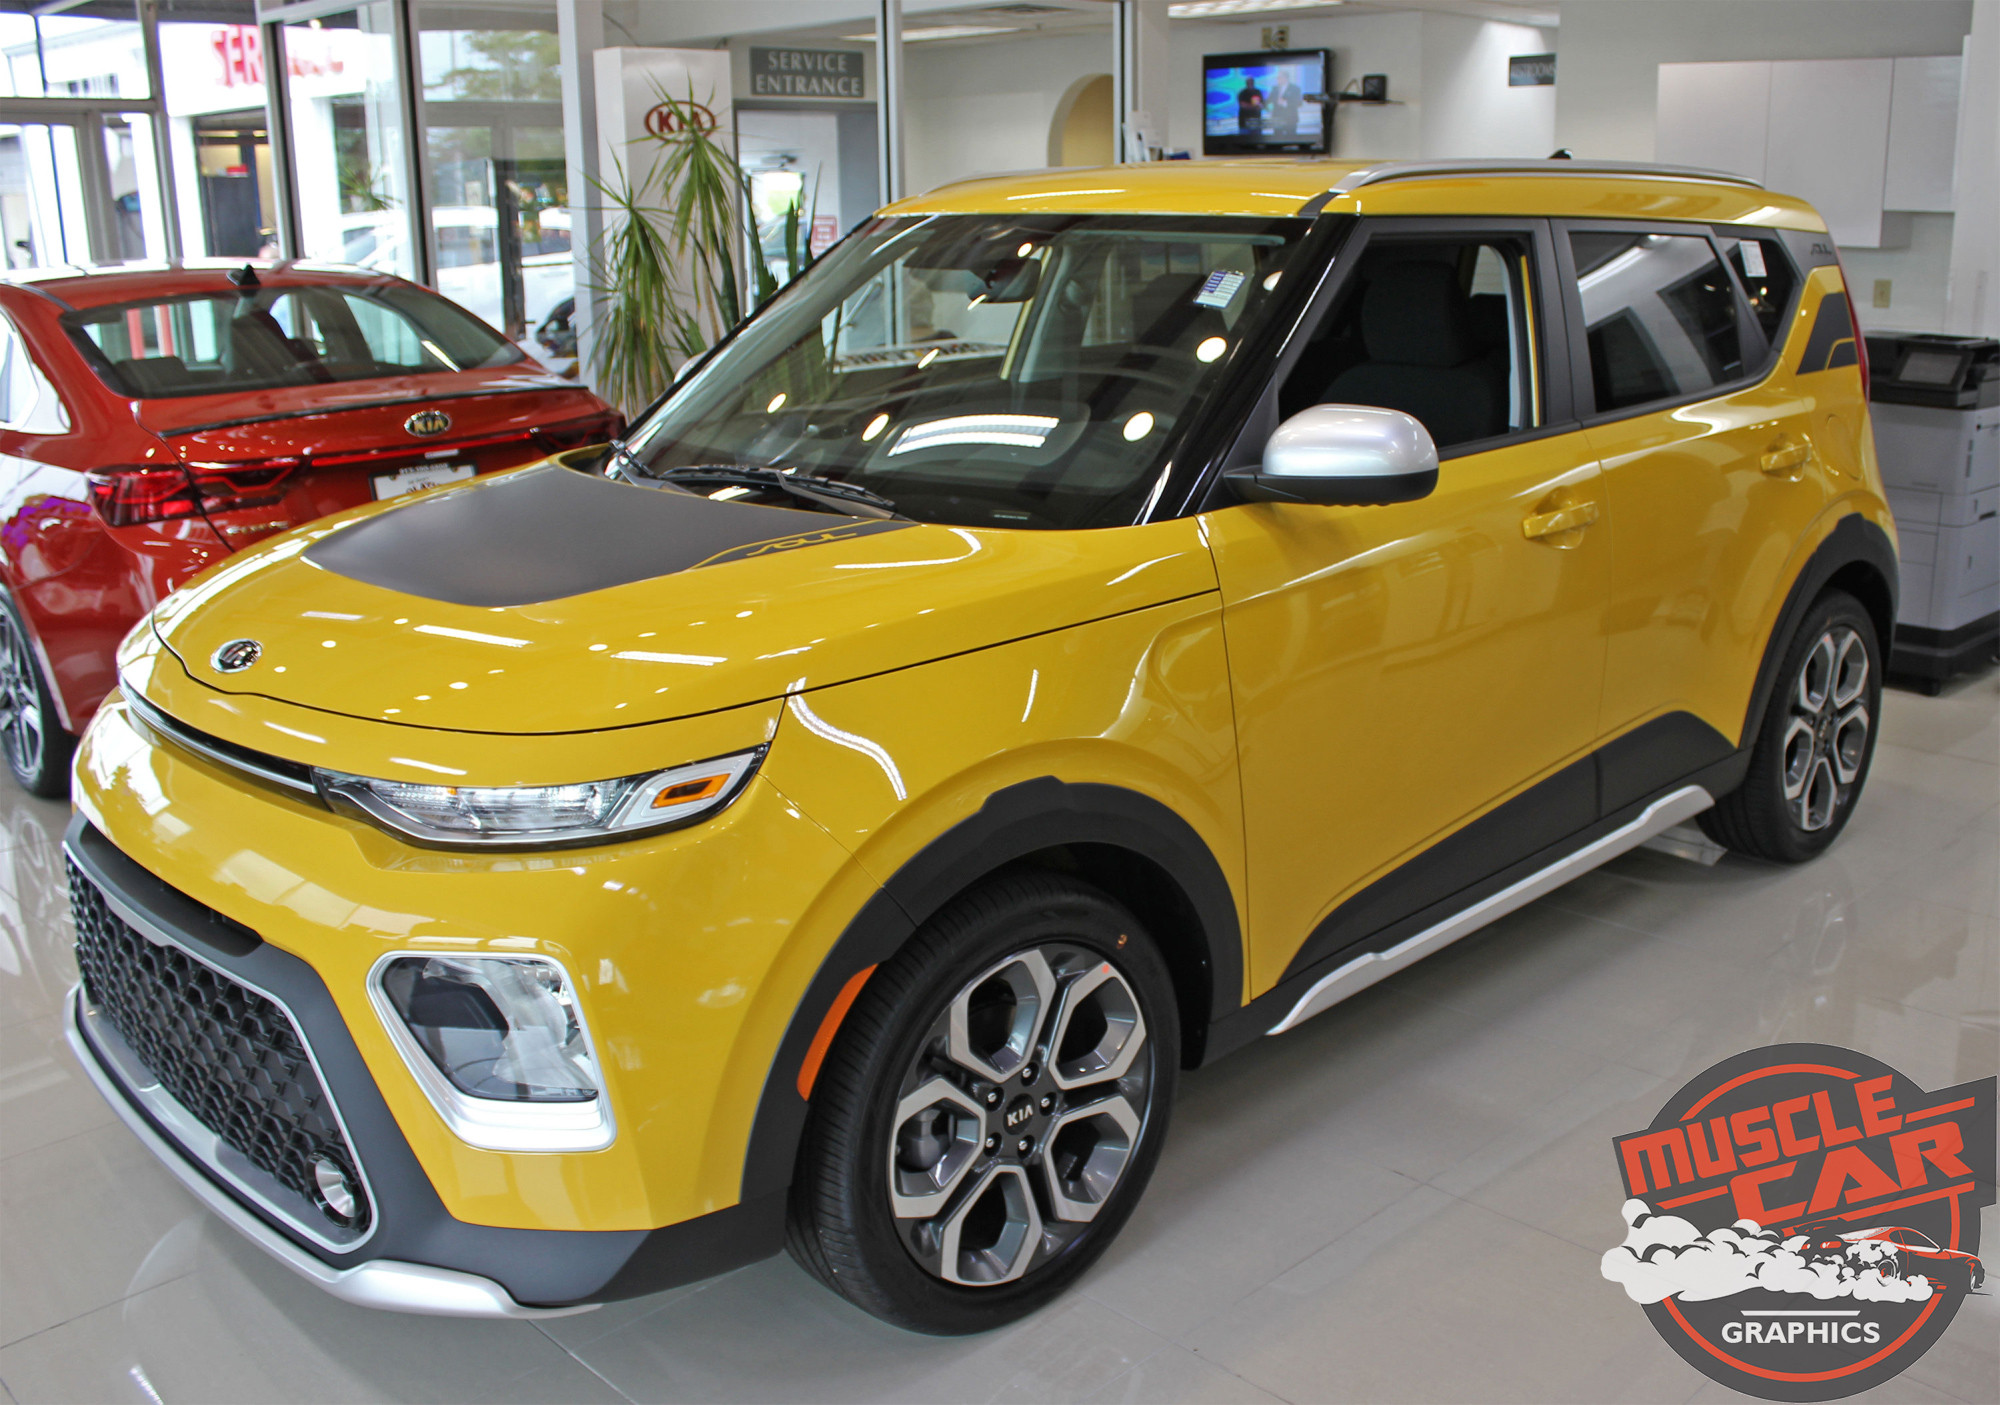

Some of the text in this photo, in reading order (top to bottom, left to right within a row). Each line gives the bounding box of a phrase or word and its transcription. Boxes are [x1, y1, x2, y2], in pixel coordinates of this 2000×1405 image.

[768, 51, 848, 73] SERVICE
[756, 74, 861, 96] ENTRANCE
[413, 416, 446, 433] KIA
[1006, 1104, 1034, 1127] KIA
